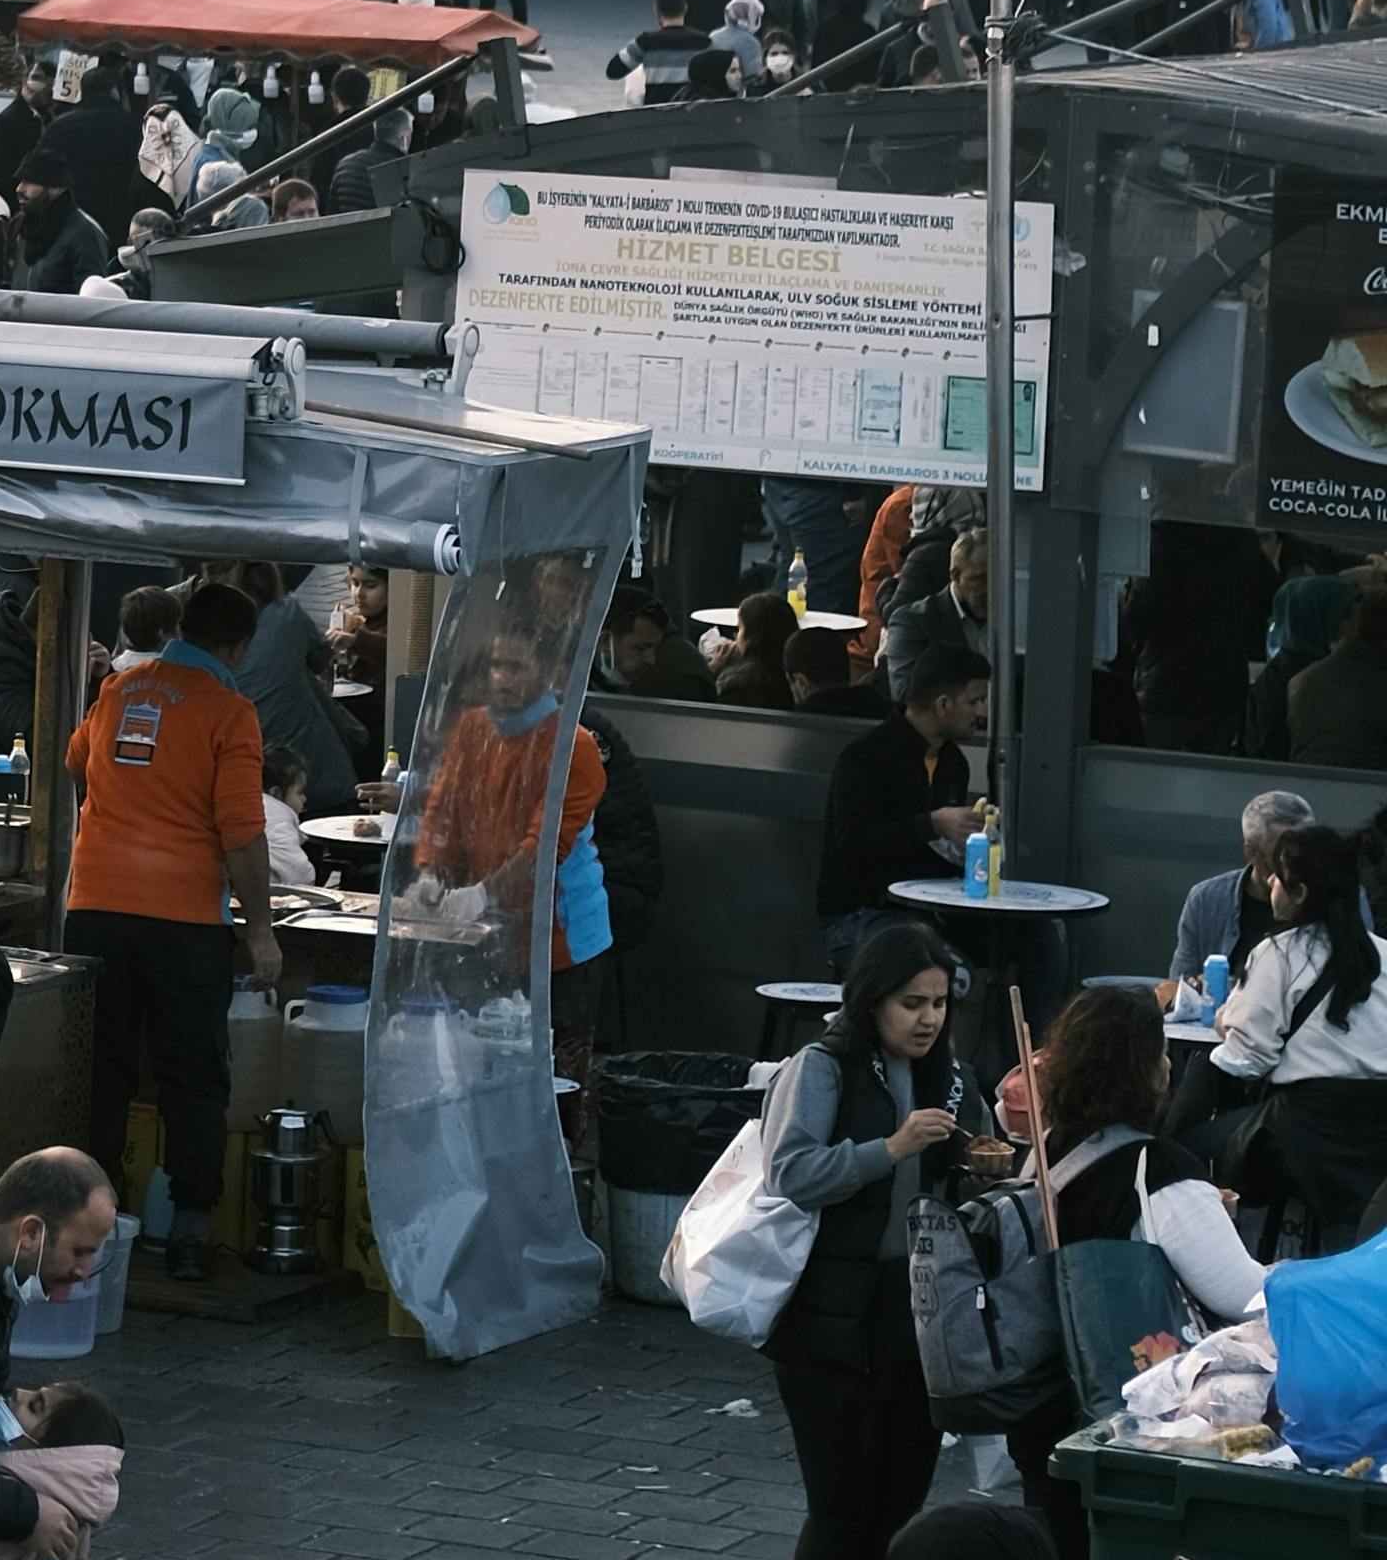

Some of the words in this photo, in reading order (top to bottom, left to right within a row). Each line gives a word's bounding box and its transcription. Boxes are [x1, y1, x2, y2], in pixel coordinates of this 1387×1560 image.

[1336, 203, 1387, 223] EKM
[617, 234, 719, 265] HİZMET
[727, 244, 842, 273] BELGESİ
[468, 288, 565, 311] DEZENFEKTE
[499, 273, 577, 290] TARAFINDAN
[580, 277, 682, 296] NANOTEKNOLOJİ
[787, 292, 812, 305] ULV
[815, 292, 859, 308] SOĞUK
[863, 295, 918, 312] SİSLEME
[922, 299, 983, 316] YÖNTEMİ
[869, 465, 939, 480] BARBAROS
[1270, 478, 1346, 498] YEMEĞİN
[1269, 497, 1372, 520] COCA-COLA
